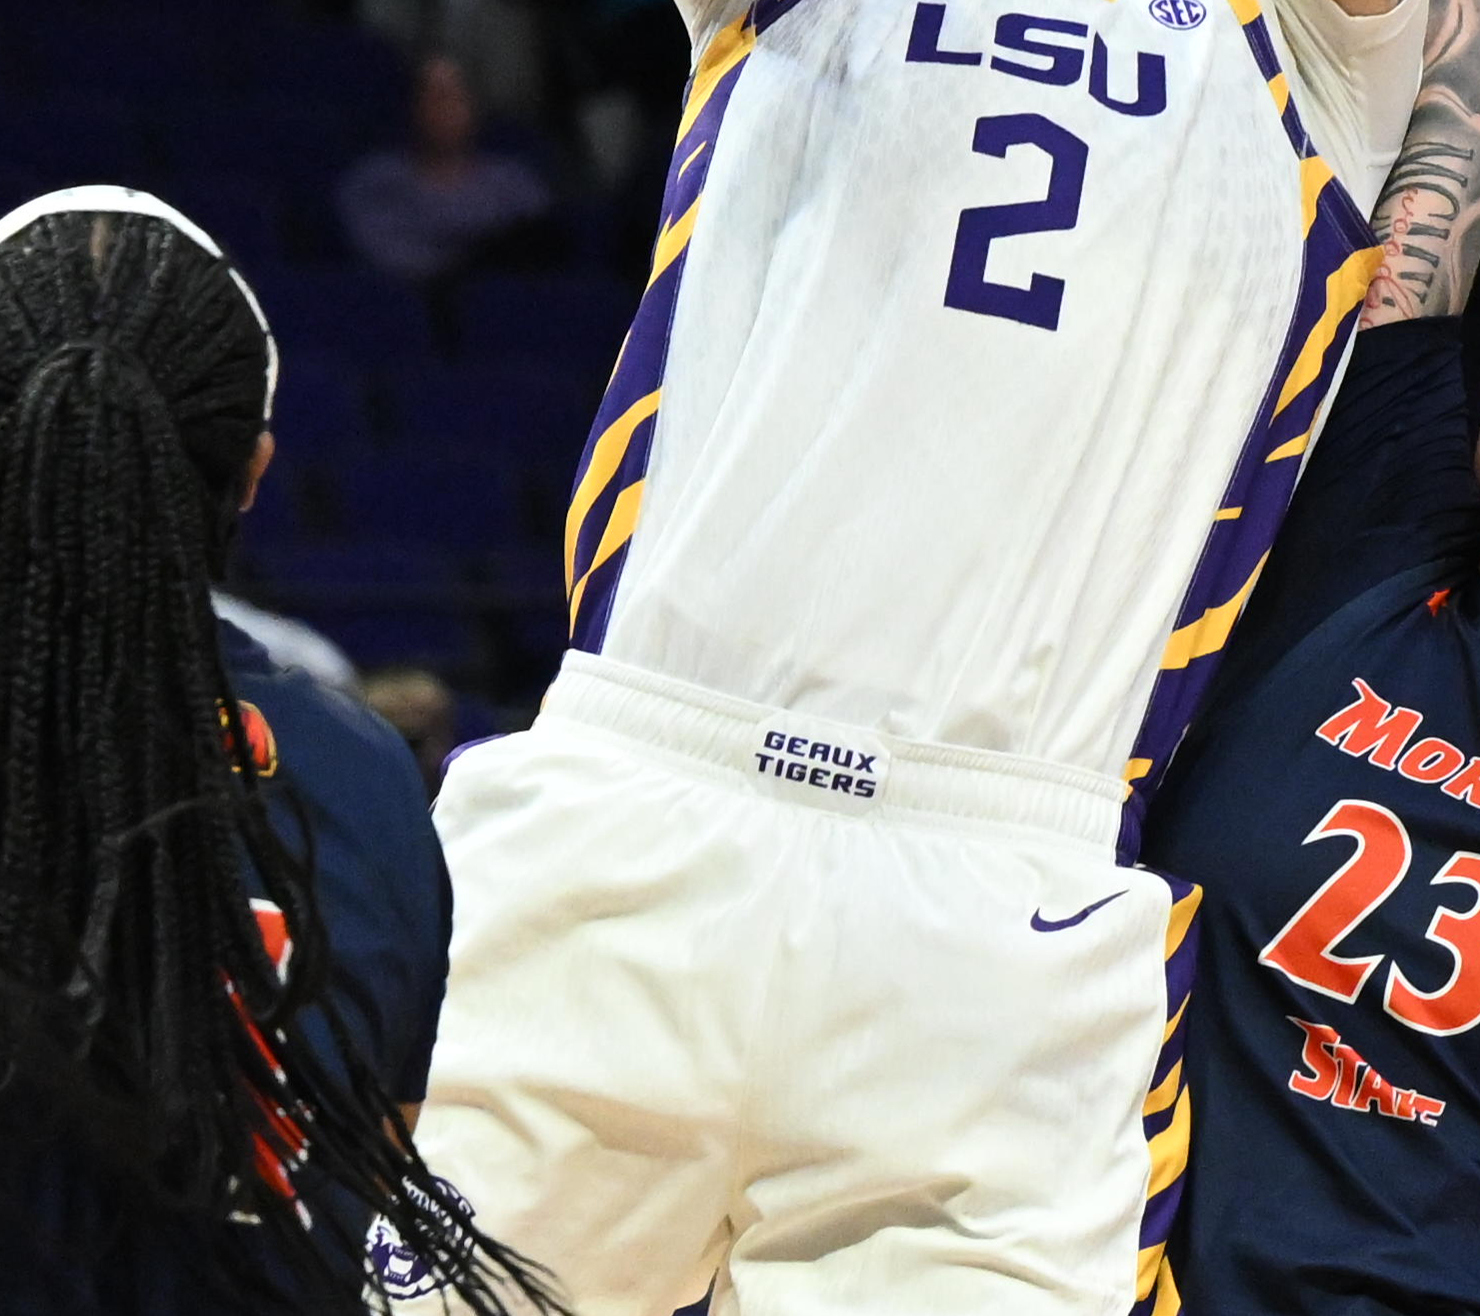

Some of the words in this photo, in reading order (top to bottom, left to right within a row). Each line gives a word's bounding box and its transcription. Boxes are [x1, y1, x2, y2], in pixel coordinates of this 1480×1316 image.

[904, 0, 1168, 117] LSU
[943, 112, 1090, 332] 2
[754, 751, 877, 799] TIGERS
[763, 729, 878, 775] GEAUX
